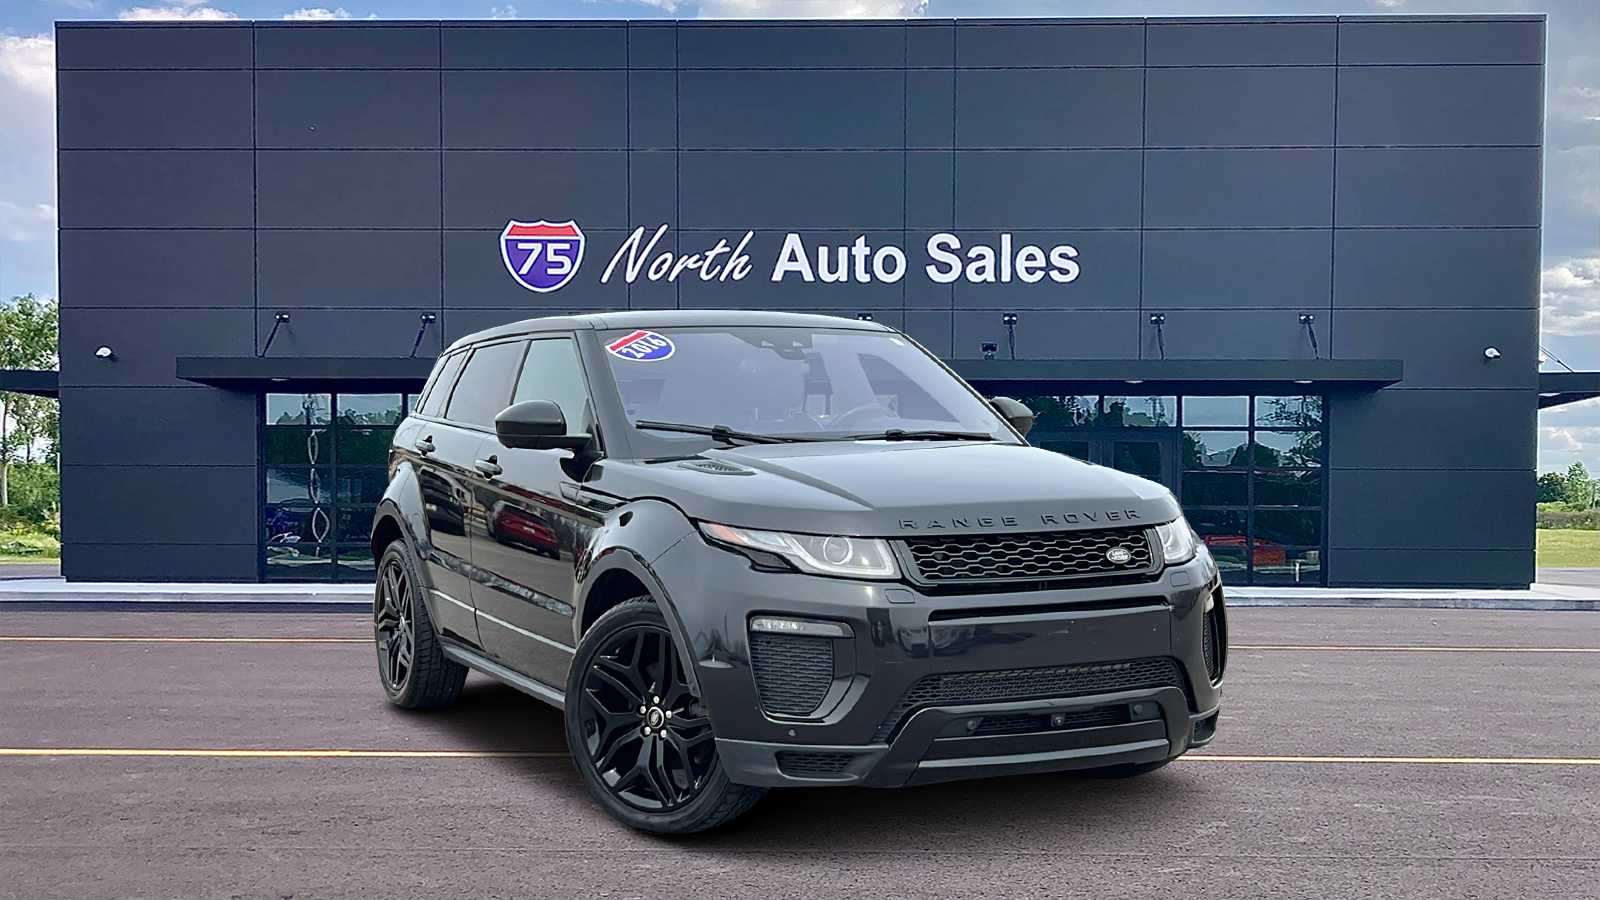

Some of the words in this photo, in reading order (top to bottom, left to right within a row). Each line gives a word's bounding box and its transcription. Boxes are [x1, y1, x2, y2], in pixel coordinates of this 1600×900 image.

[517, 242, 572, 275] 75
[601, 223, 755, 283] North
[770, 233, 907, 283] Auto
[925, 233, 1081, 283] Sales
[621, 336, 668, 359] 2016
[898, 516, 1018, 530] RANGE
[1040, 509, 1142, 526] ROVER
